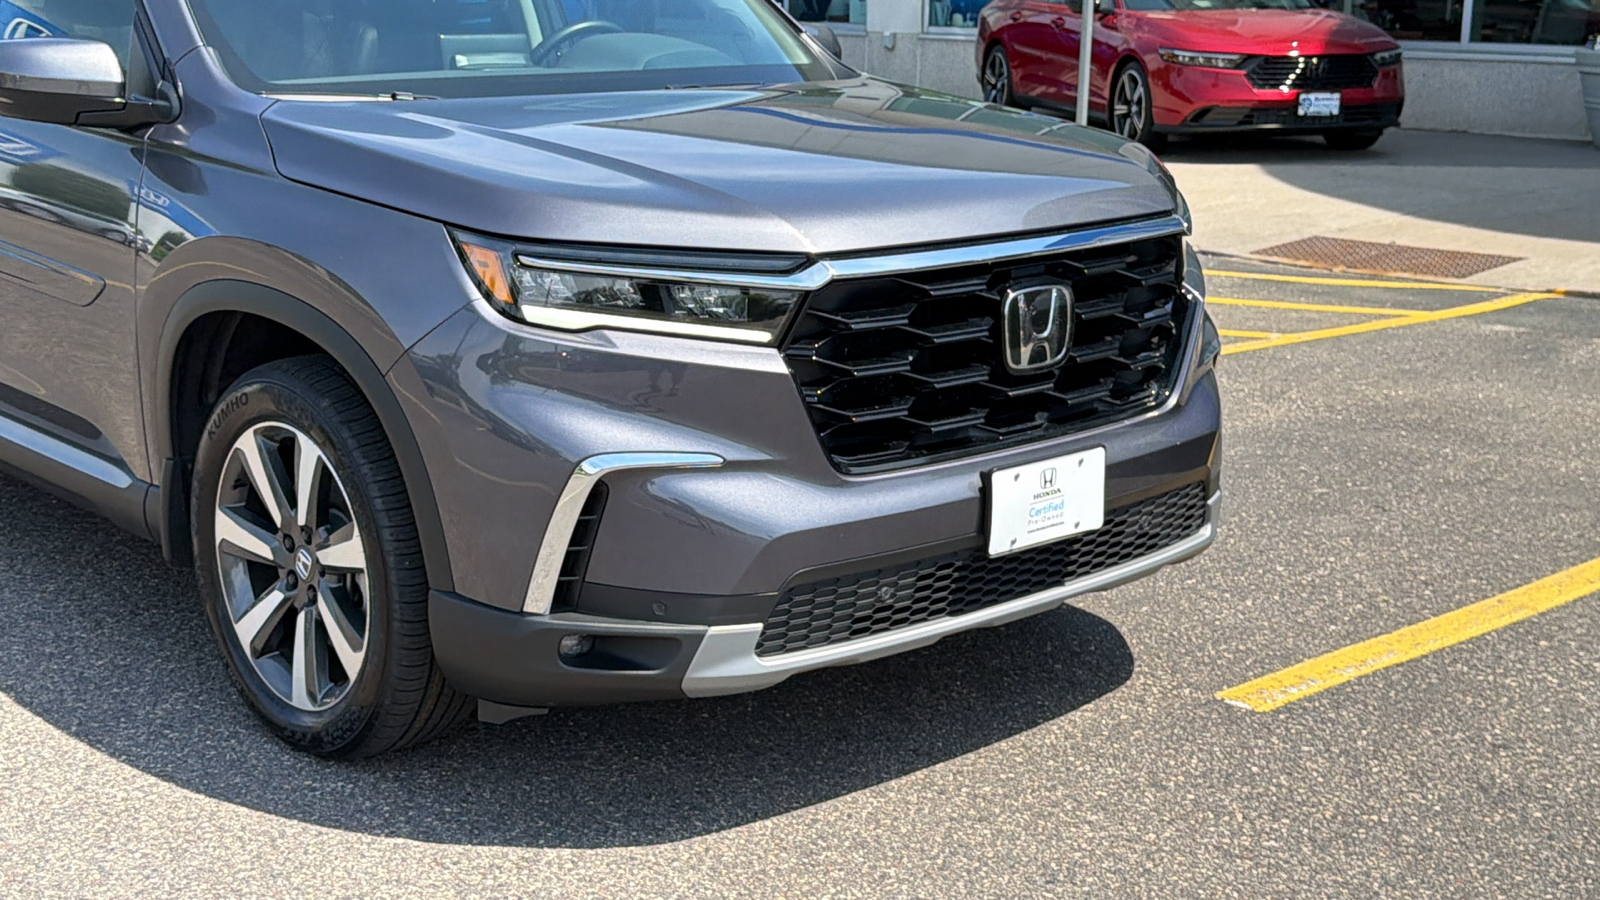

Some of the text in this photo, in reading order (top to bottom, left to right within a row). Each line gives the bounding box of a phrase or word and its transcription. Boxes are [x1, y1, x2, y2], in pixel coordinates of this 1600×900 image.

[207, 392, 250, 441] KUMHO
[1033, 487, 1062, 500] HONDA
[1028, 500, 1065, 518] Certified
